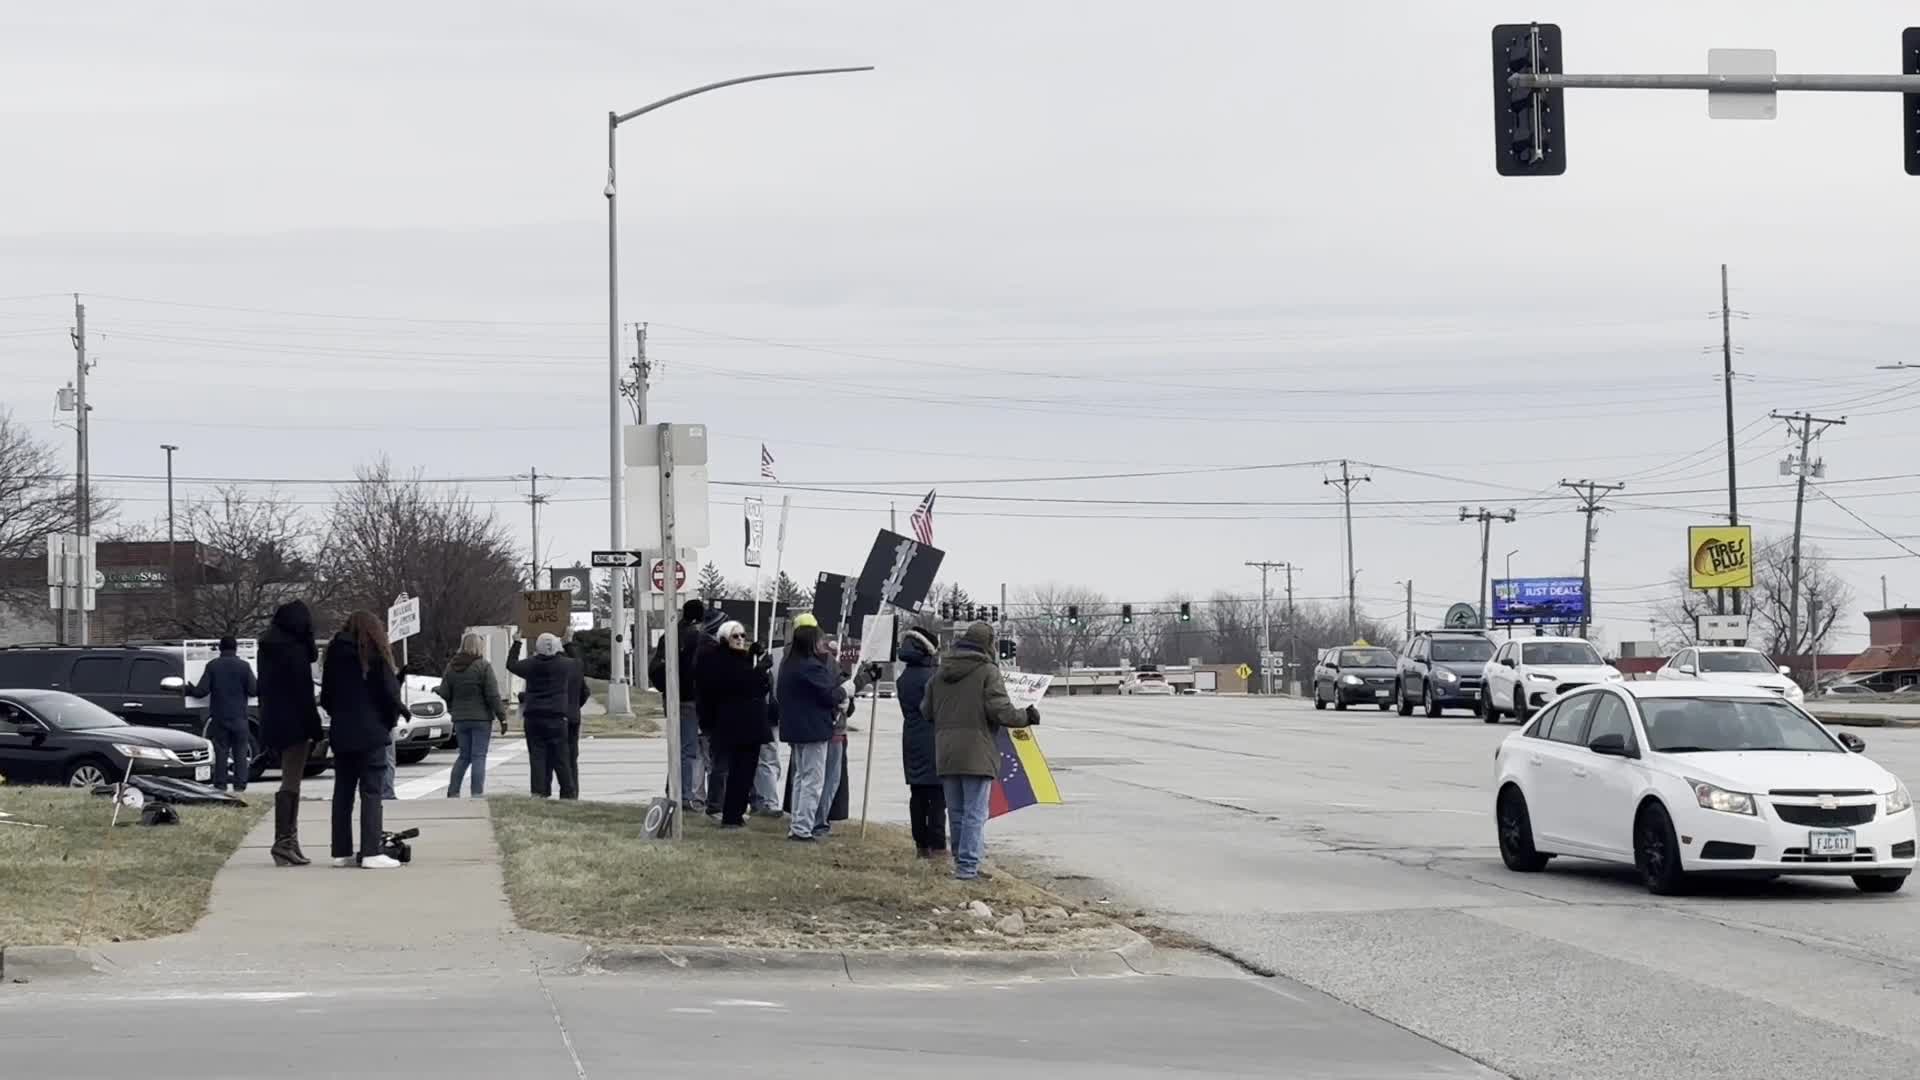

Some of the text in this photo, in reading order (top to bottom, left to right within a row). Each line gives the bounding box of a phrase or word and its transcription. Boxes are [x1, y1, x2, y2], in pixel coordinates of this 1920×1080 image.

[1707, 538, 1745, 558] TIRES
[596, 555, 610, 563] ONE
[1712, 552, 1745, 572] PLUS
[1525, 587, 1547, 596] JUST
